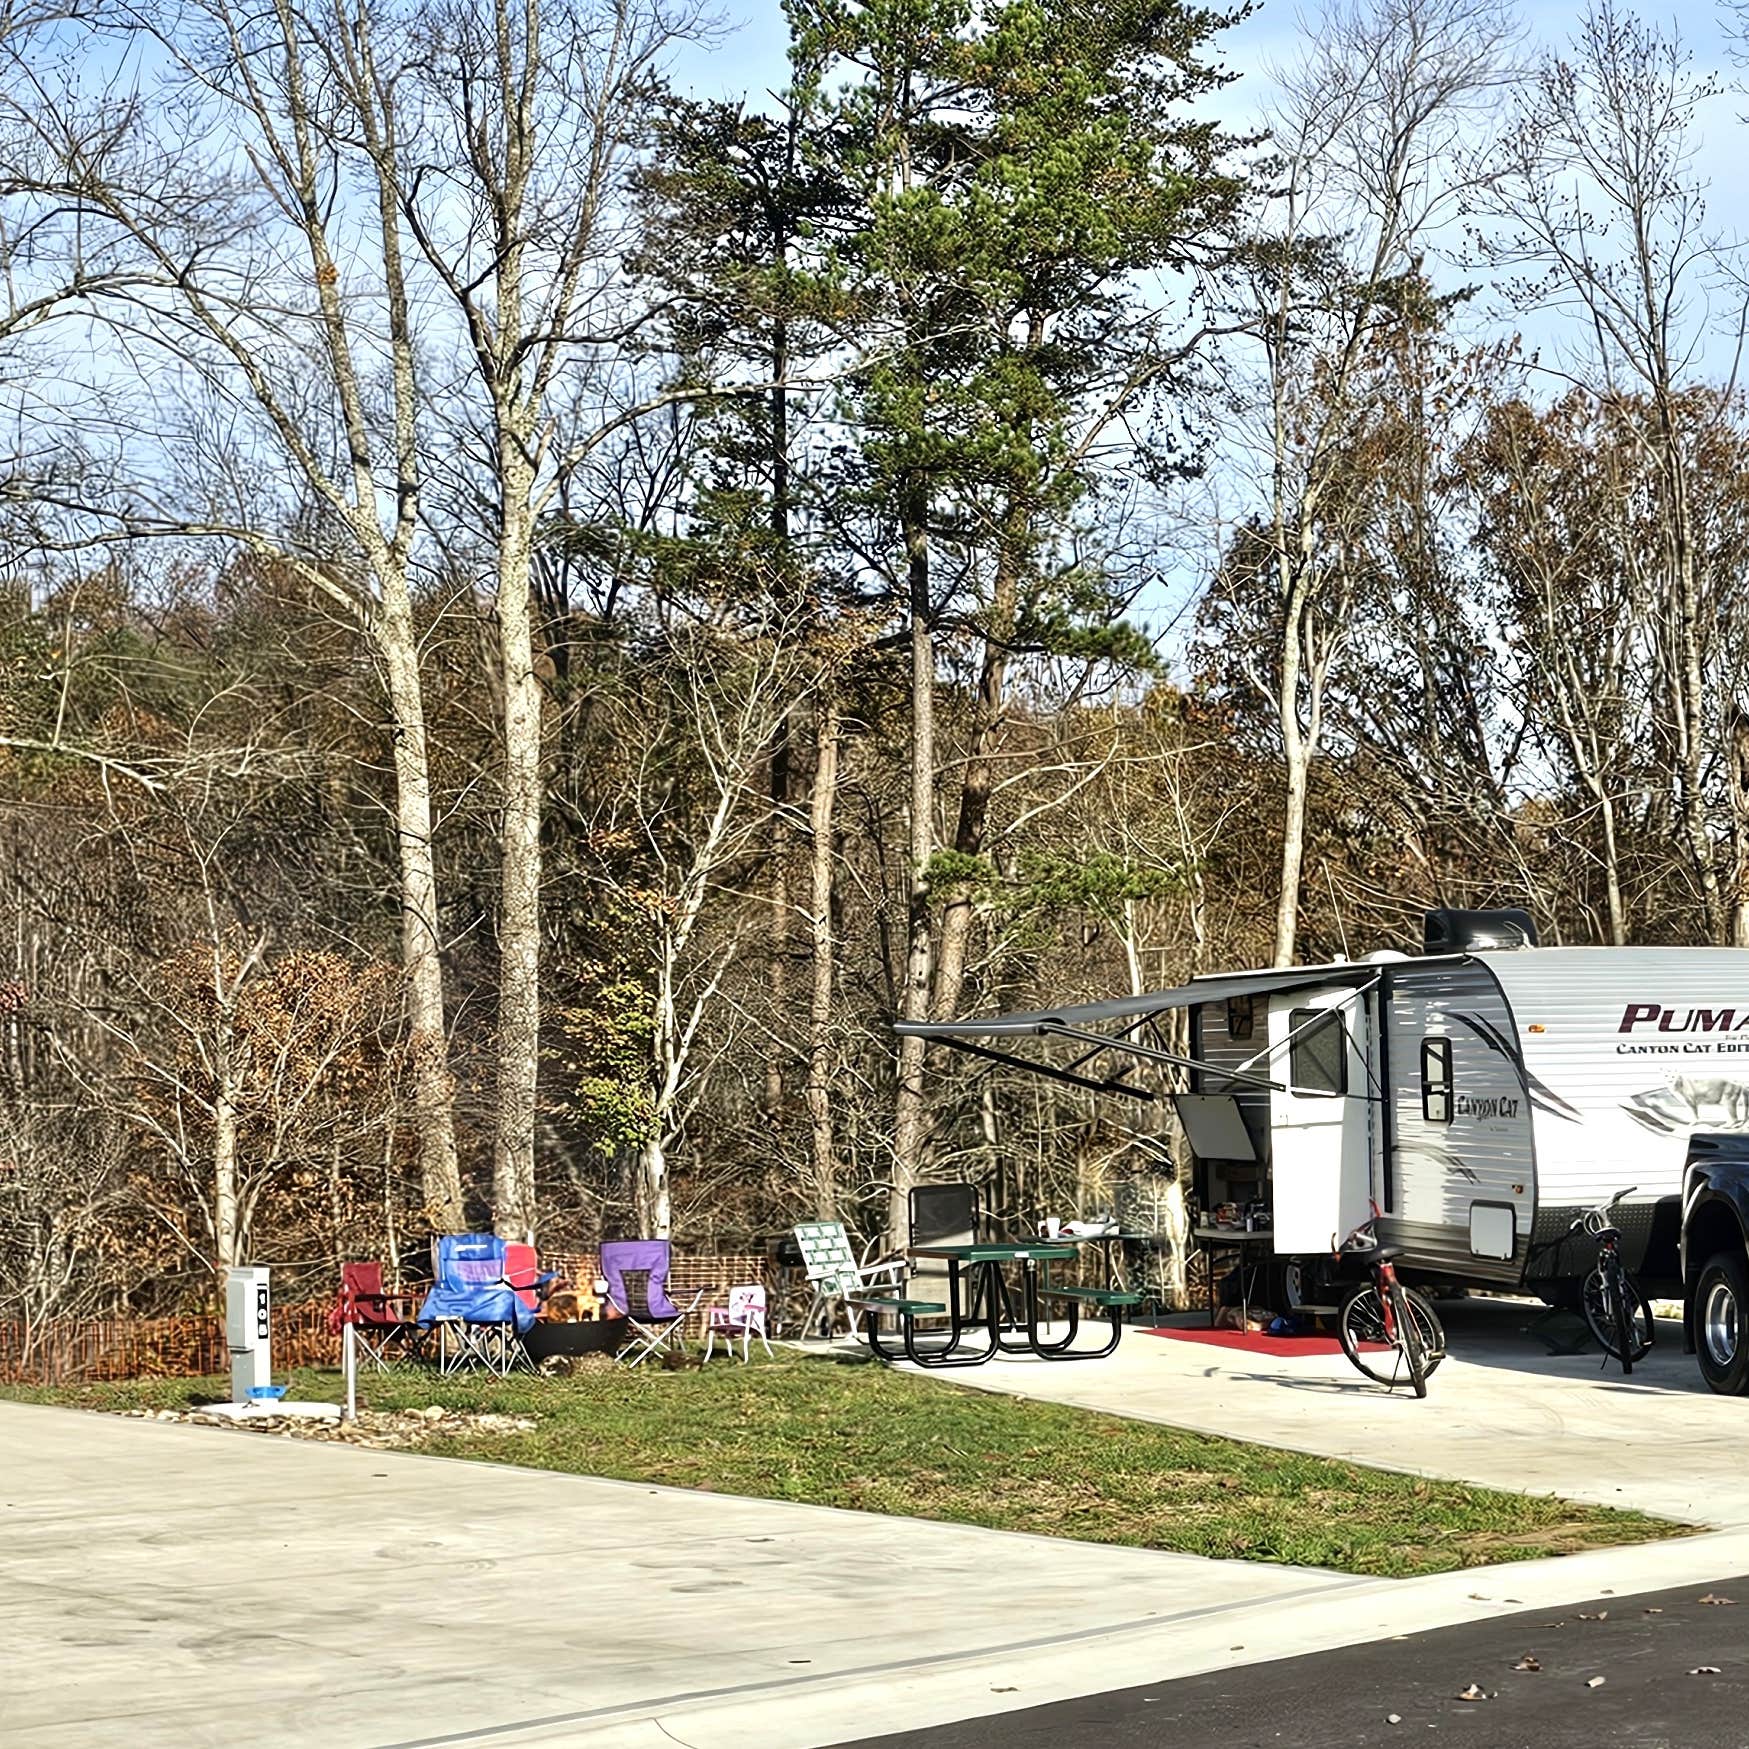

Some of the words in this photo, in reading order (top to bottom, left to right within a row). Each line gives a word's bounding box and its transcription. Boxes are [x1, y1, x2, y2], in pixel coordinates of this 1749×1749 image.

[1616, 1042, 1679, 1054] CANYON
[1683, 1042, 1712, 1053] CAT
[1457, 1095, 1498, 1121] CANYON
[1499, 1096, 1518, 1118] CAT
